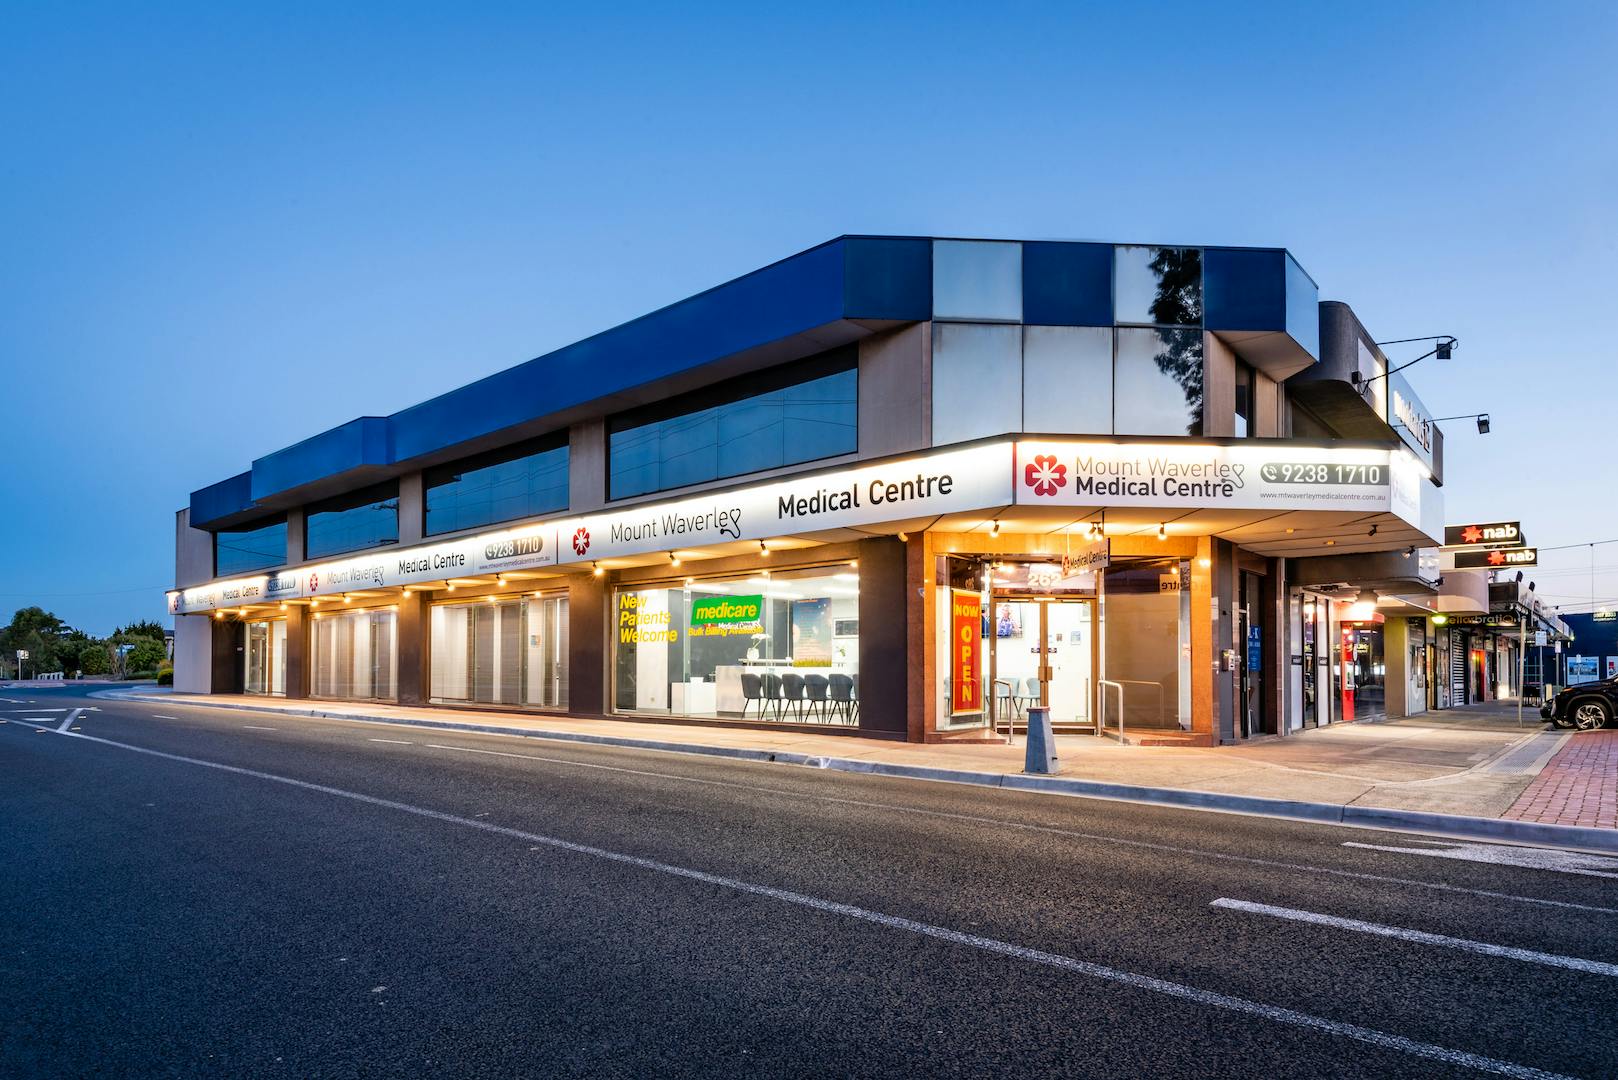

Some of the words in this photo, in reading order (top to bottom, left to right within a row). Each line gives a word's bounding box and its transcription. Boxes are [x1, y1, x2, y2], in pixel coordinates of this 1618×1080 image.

[1075, 456, 1142, 476] Mount
[1148, 457, 1245, 489] Waverley
[1281, 464, 1329, 483] 9238
[1335, 465, 1380, 484] 1710
[1075, 476, 1158, 496] Medical
[1163, 477, 1234, 498] Centre
[1259, 492, 1386, 502] www.mtwaverleymedicalcentre.com.au
[611, 518, 657, 544] Mount
[661, 505, 741, 539] Waverley
[778, 483, 861, 519] Medical
[869, 473, 953, 505] Centre
[1482, 524, 1518, 540] nab
[492, 541, 514, 558] 9238
[516, 537, 539, 554] 1710
[1505, 549, 1536, 562] nab
[326, 570, 349, 585] Mount
[350, 564, 384, 586] Waverley
[398, 555, 431, 575] Medical
[433, 552, 465, 569] Centre
[1070, 552, 1089, 569] Medical
[1027, 573, 1062, 587] 262
[619, 594, 648, 609] New
[695, 601, 757, 619] medicare
[619, 610, 672, 626] Patients
[955, 604, 979, 618] NOW
[620, 627, 678, 644] Welcome
[687, 627, 704, 637] Bulk
[960, 625, 973, 702] OPEN
